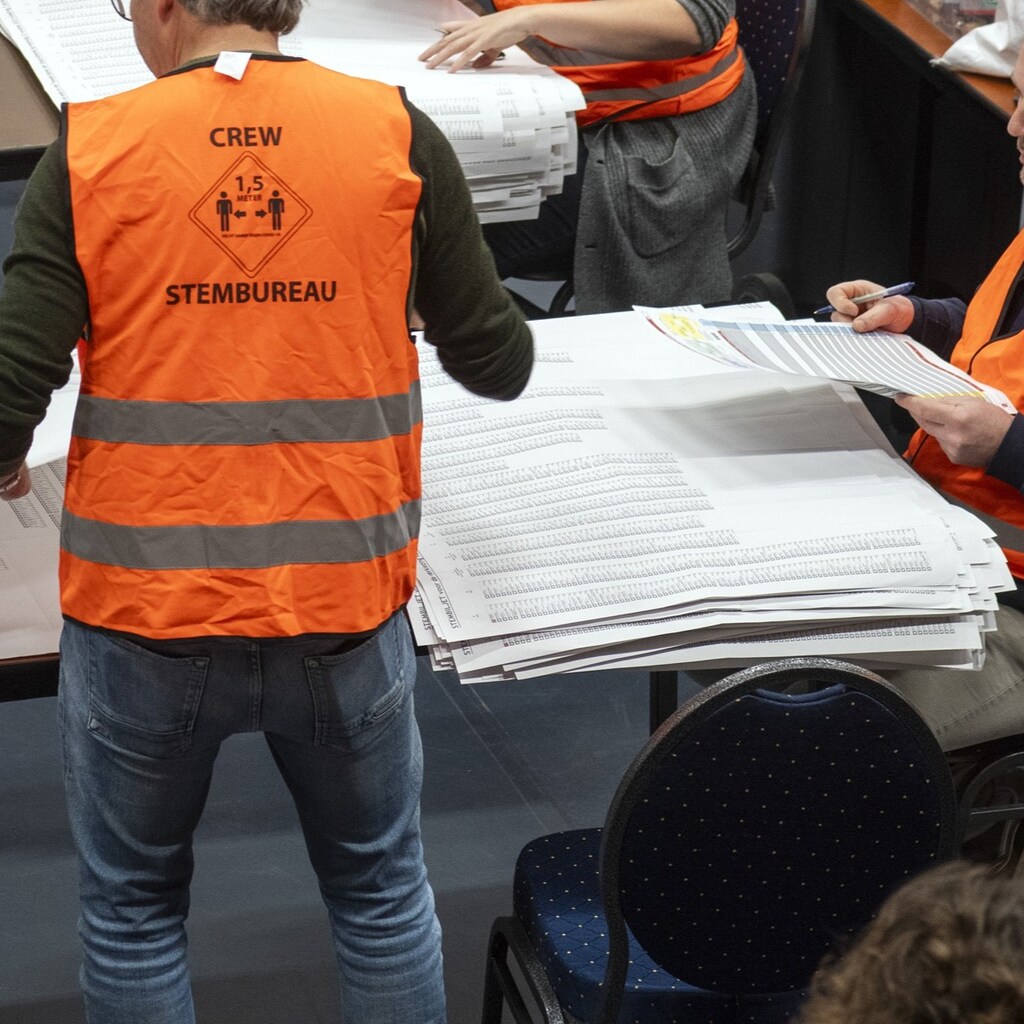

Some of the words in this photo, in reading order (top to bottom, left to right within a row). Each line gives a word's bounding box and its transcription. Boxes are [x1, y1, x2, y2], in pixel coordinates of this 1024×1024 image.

[209, 126, 283, 148] CREW
[235, 176, 264, 194] 1,5
[236, 194, 263, 202] METER
[165, 280, 337, 306] STEMBUREAU
[439, 595, 459, 630] STEMBILJET
